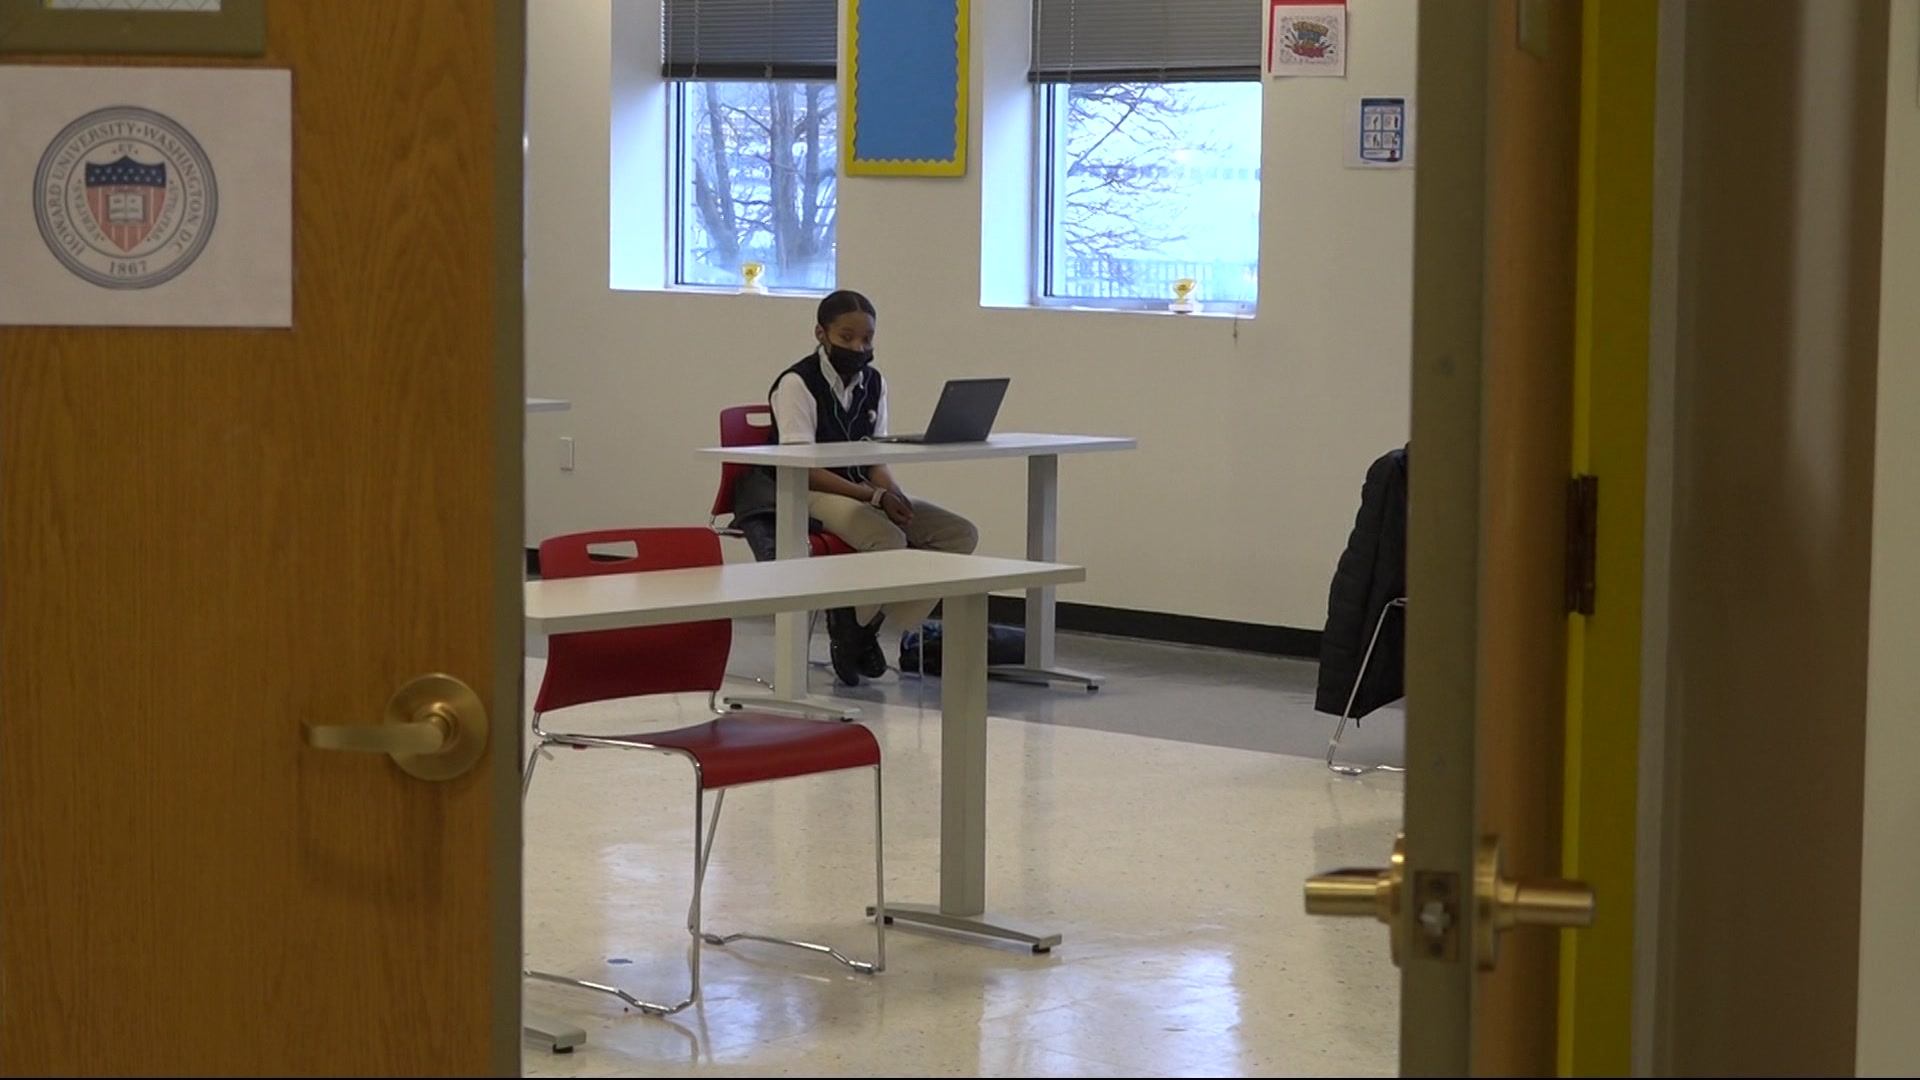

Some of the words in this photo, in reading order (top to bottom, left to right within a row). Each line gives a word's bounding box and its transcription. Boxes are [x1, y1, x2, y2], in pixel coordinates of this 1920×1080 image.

[52, 122, 135, 181] UNIVERSITY
[143, 125, 202, 225] WASHINGTON
[48, 184, 86, 257] HOWARD
[109, 260, 148, 275] 1867
